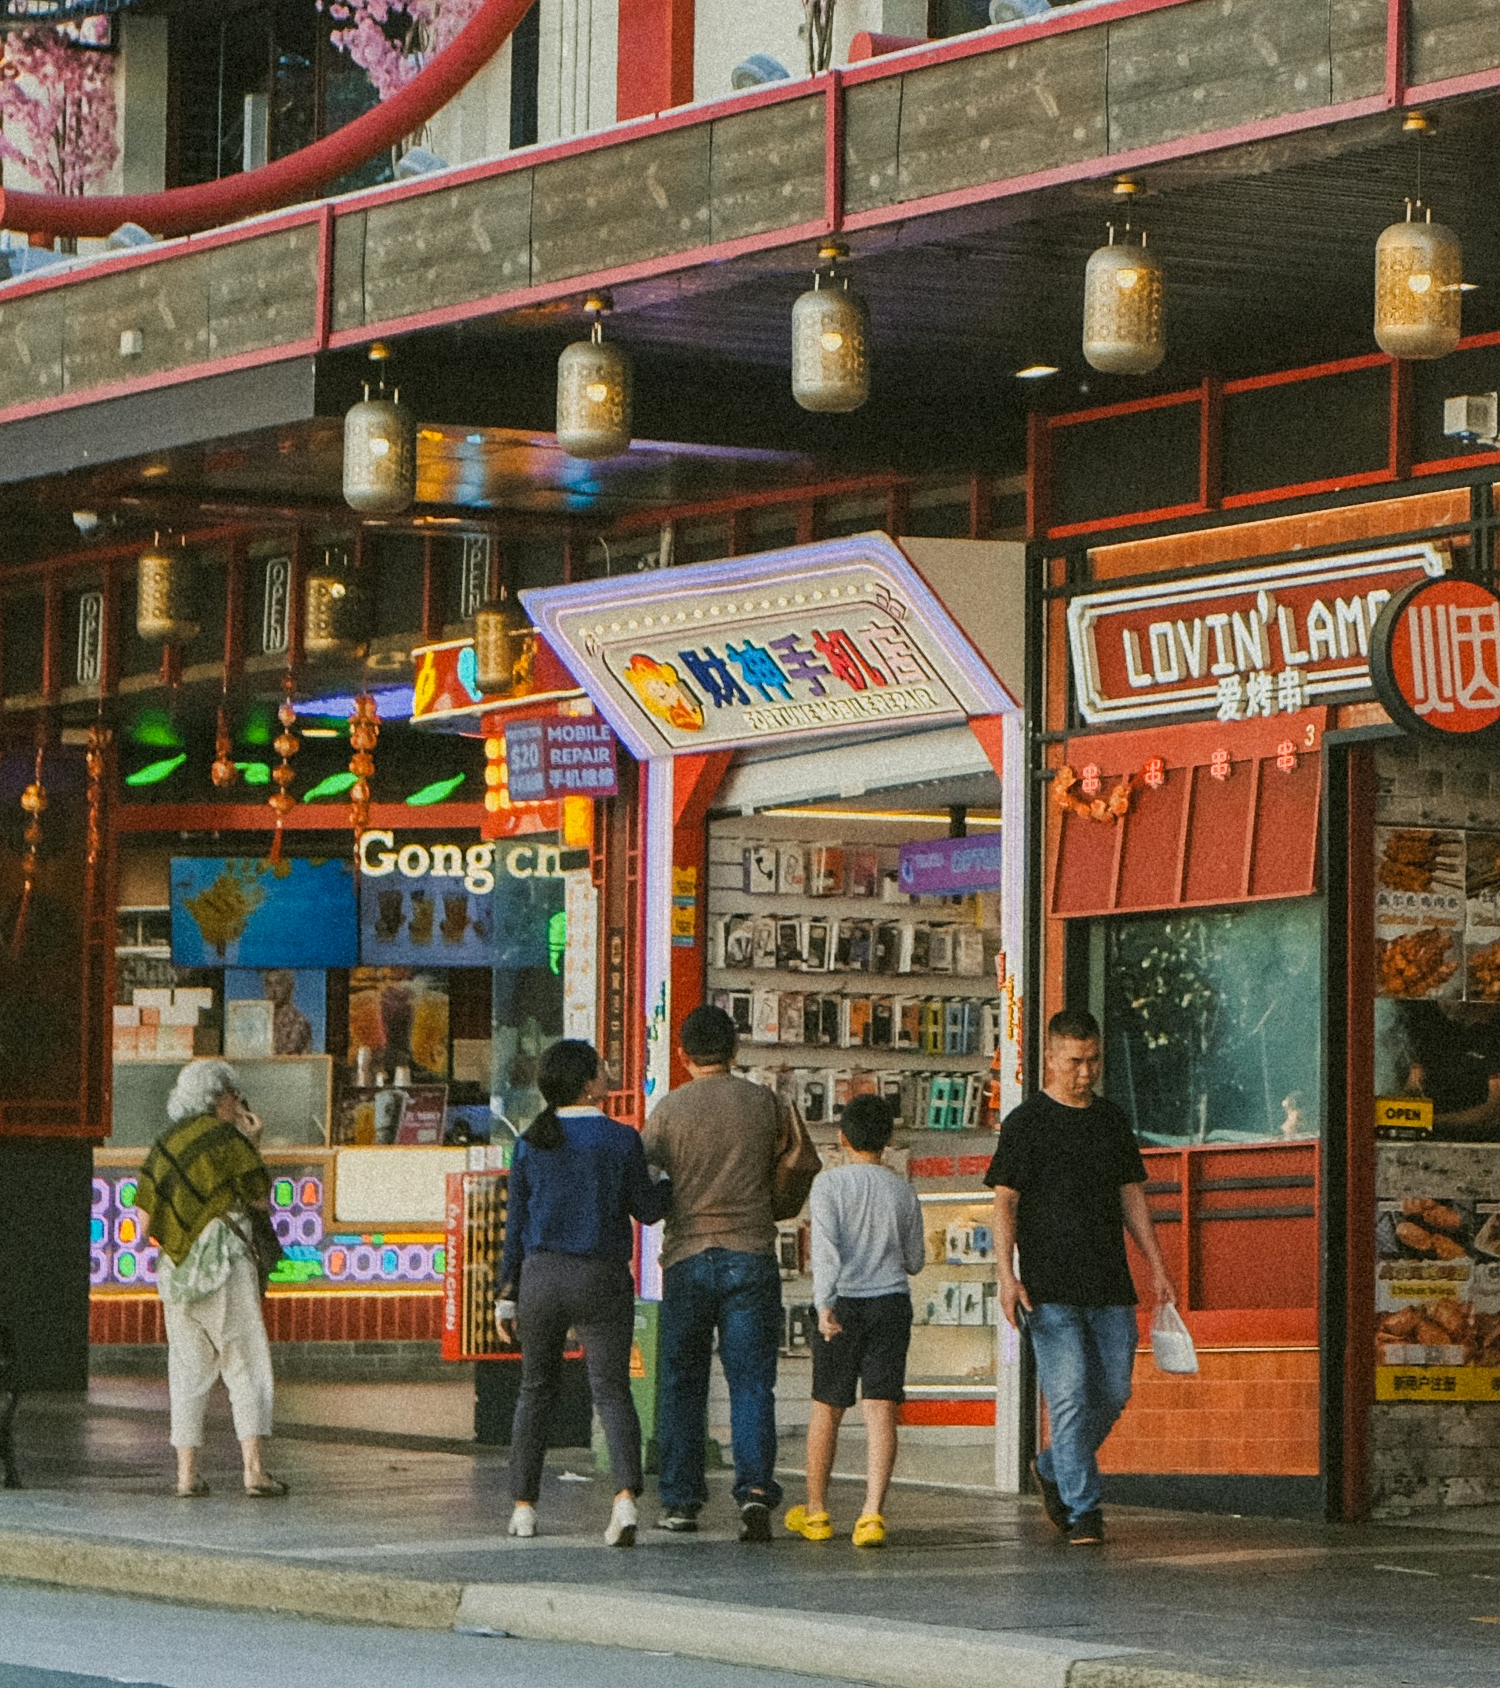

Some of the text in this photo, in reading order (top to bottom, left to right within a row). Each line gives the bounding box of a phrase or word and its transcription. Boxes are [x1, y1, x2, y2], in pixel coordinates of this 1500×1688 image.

[268, 567, 284, 650] OPEN
[83, 597, 98, 680] OPEN
[678, 620, 932, 709] 财神手机店
[744, 687, 939, 731] FORTUNE MOBILE REPAIR
[1215, 666, 1303, 722] 爱烤串
[547, 724, 611, 742] MOBILE
[1304, 723, 1316, 748] 3
[510, 742, 540, 772] $20
[550, 746, 611, 764] REPAIR
[1210, 748, 1231, 781] 串
[1277, 739, 1297, 773] 串
[360, 829, 497, 895] Gong
[1385, 1105, 1422, 1125] OPEN
